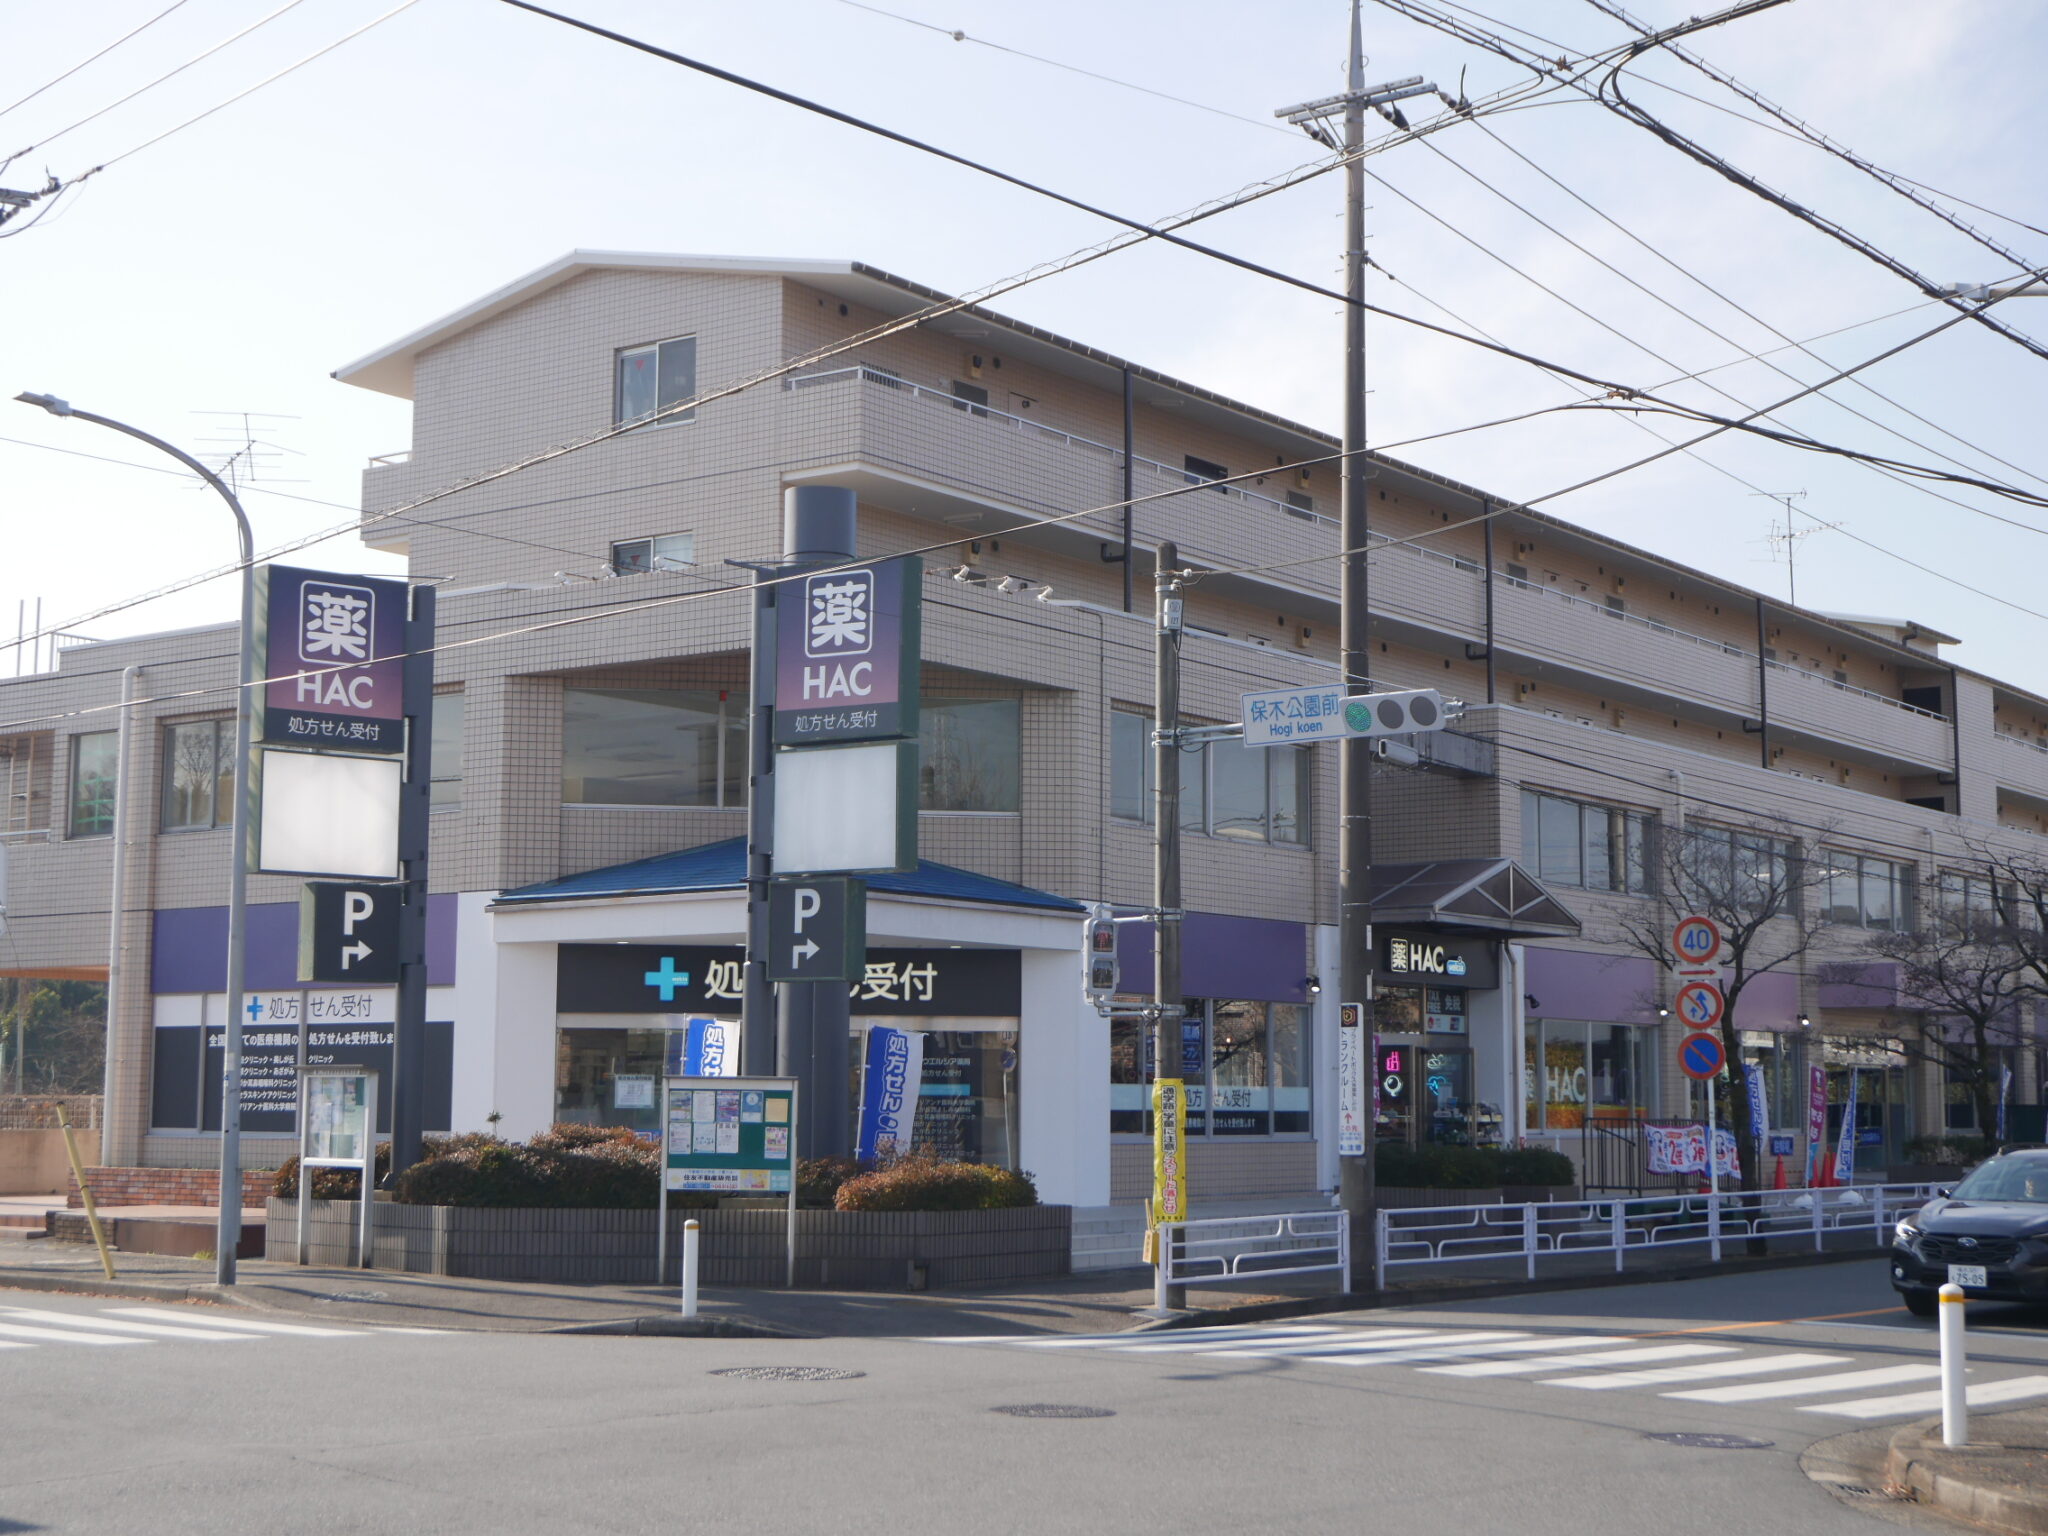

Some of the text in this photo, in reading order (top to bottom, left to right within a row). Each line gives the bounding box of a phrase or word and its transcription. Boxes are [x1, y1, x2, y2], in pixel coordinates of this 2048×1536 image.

[306, 592, 368, 659] 薬
[812, 580, 867, 648] 薬
[297, 669, 374, 709] HAC
[803, 661, 873, 700] HAC
[288, 716, 381, 742] 処方せん受付
[795, 709, 878, 733] 処方せん受付
[1270, 720, 1323, 737] Hogi koen
[343, 890, 374, 936] P
[793, 888, 821, 933] P
[1392, 942, 1407, 969] 薬
[1410, 943, 1444, 973] HAC
[1683, 929, 1710, 950] 40
[269, 994, 373, 1019] 処方せん受付
[1544, 1065, 1586, 1102] HAC
